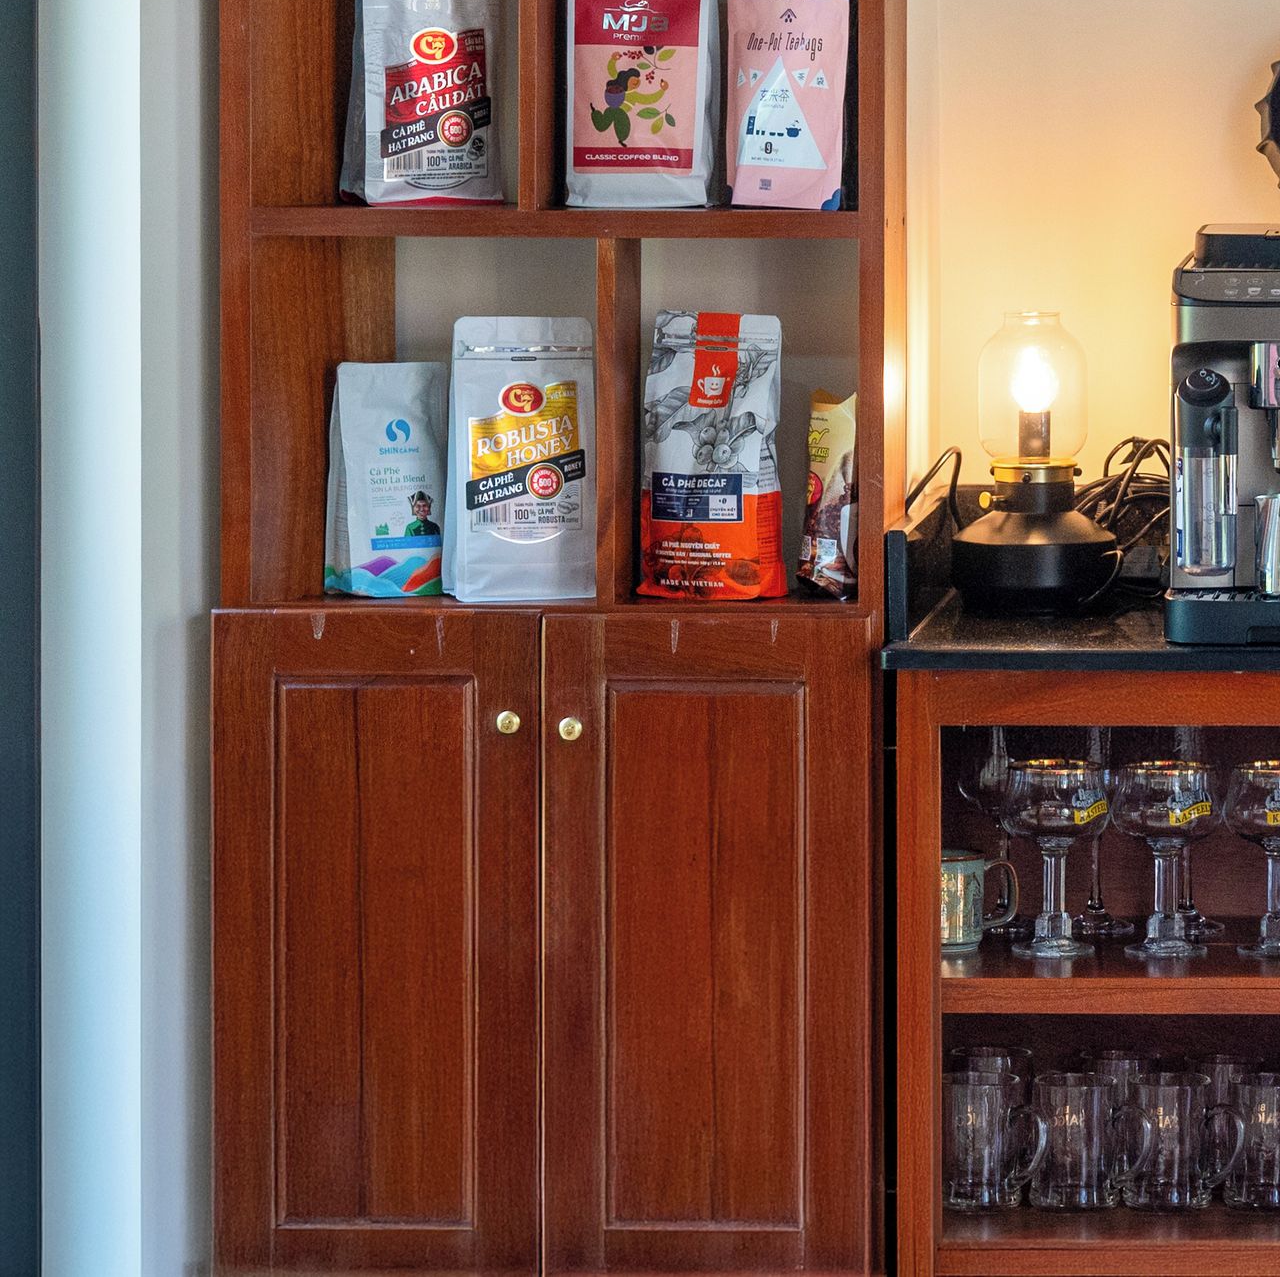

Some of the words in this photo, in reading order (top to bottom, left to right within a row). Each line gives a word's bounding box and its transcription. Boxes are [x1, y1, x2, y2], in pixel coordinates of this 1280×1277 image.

[747, 32, 782, 51] One-Pot
[390, 61, 483, 106] ARABICA
[416, 92, 450, 116] CẦU
[392, 124, 406, 139] CÀ
[407, 119, 426, 135] PHÊ
[408, 131, 435, 148] RANG
[652, 154, 679, 162] BLEND
[477, 414, 574, 457] ROBUSTA
[379, 446, 398, 455] SHIN
[507, 433, 574, 468] HONEY
[403, 474, 425, 483] Blend
[479, 475, 494, 491] CÀ
[495, 472, 514, 487] PHÊ
[697, 478, 727, 488] DECAF
[494, 483, 524, 499] RANG
[538, 515, 565, 524] ROBUSTA
[691, 580, 724, 588] VIETNAM
